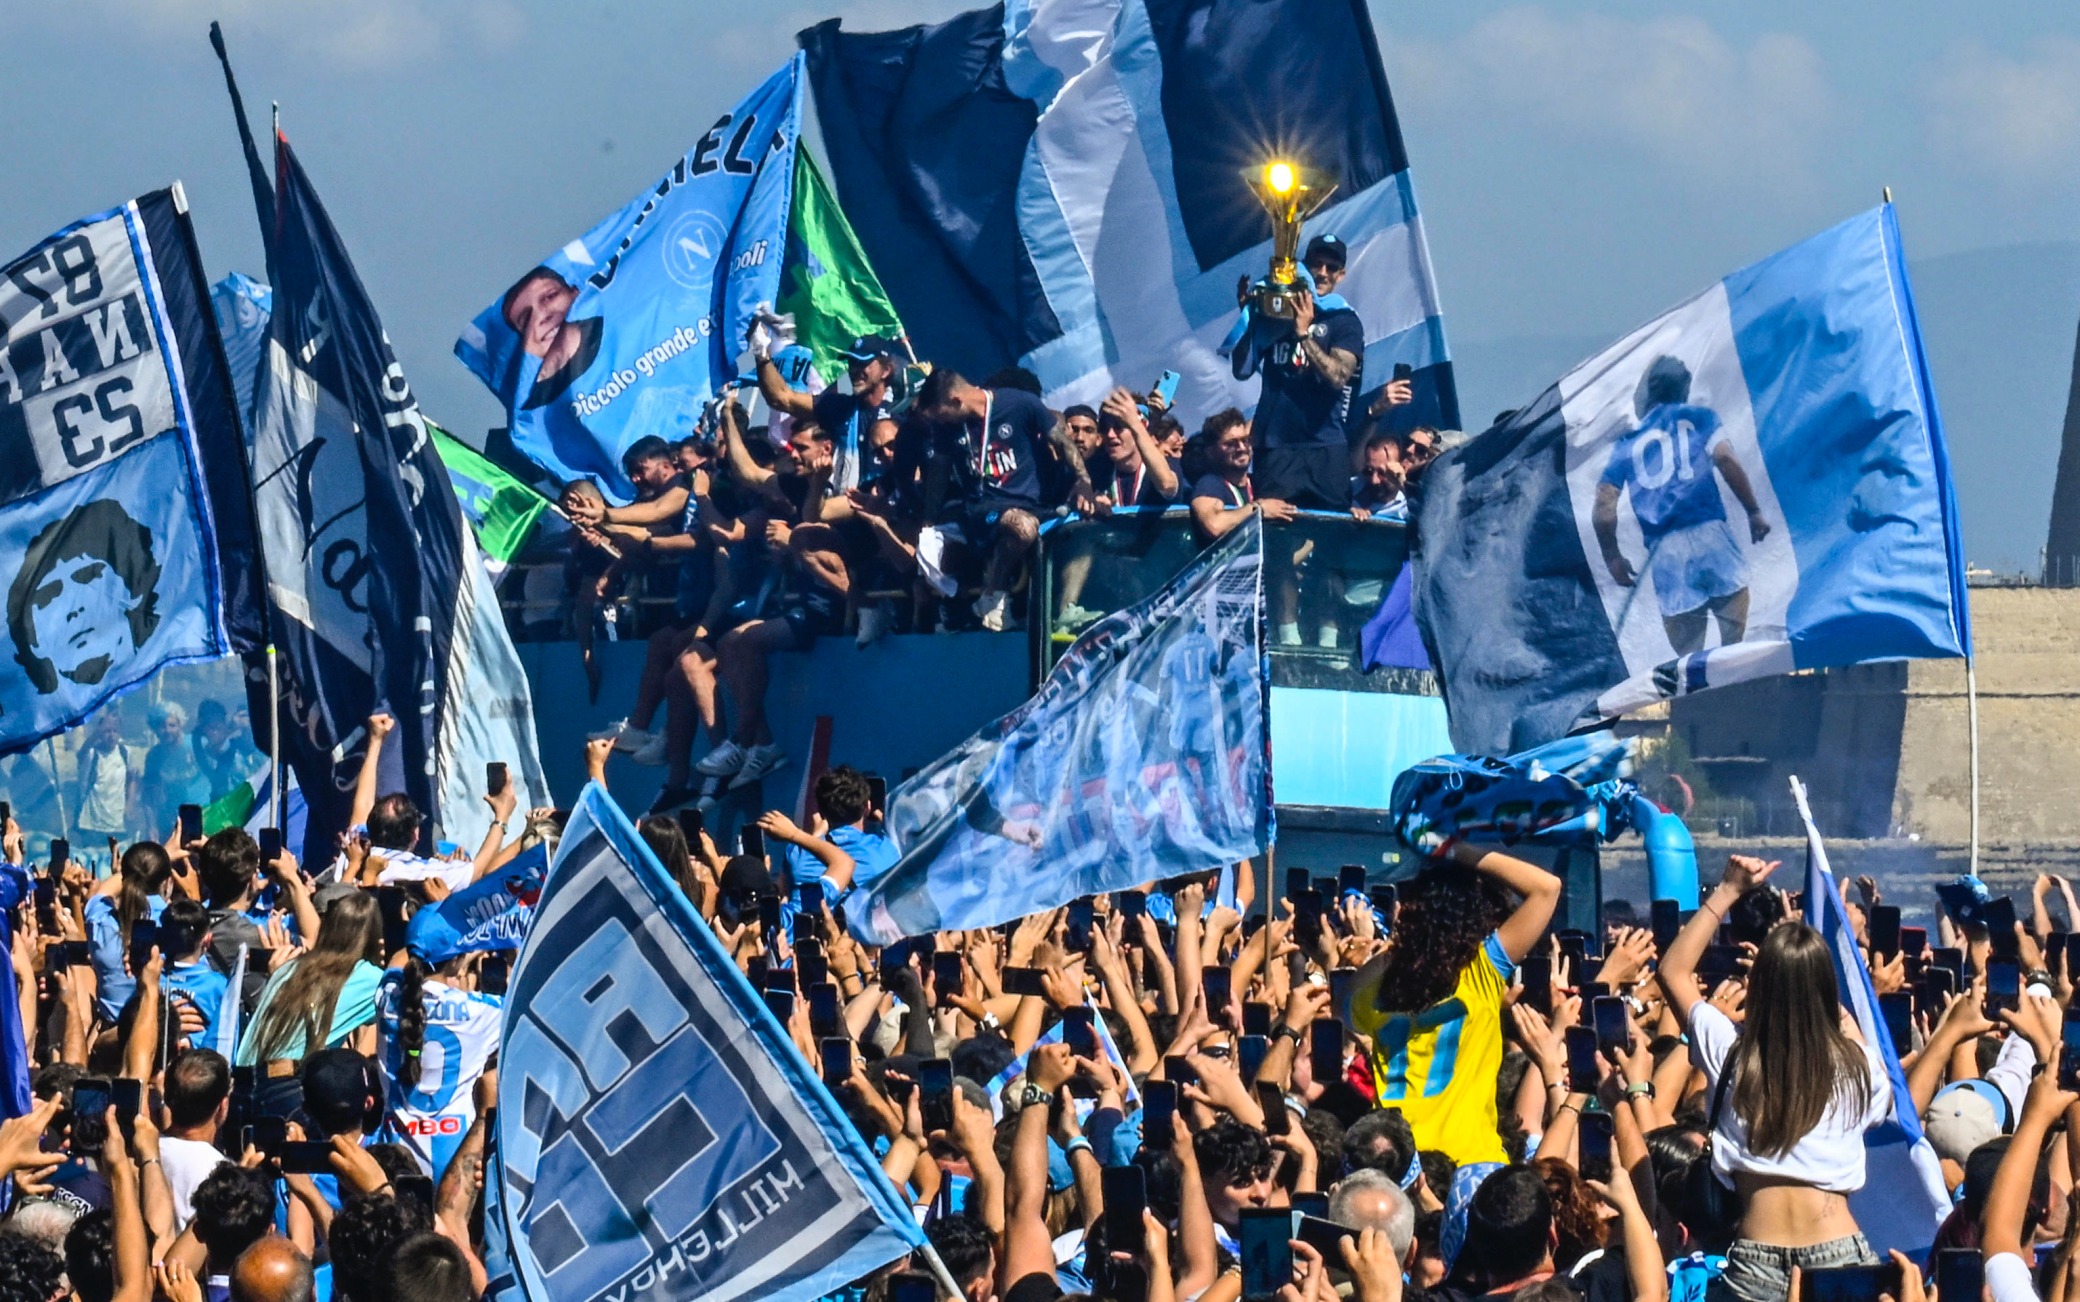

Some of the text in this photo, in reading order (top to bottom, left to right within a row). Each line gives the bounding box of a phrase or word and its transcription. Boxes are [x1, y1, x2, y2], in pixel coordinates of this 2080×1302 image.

[678, 228, 712, 271] N
[728, 240, 768, 278] poli
[634, 327, 699, 377] grande
